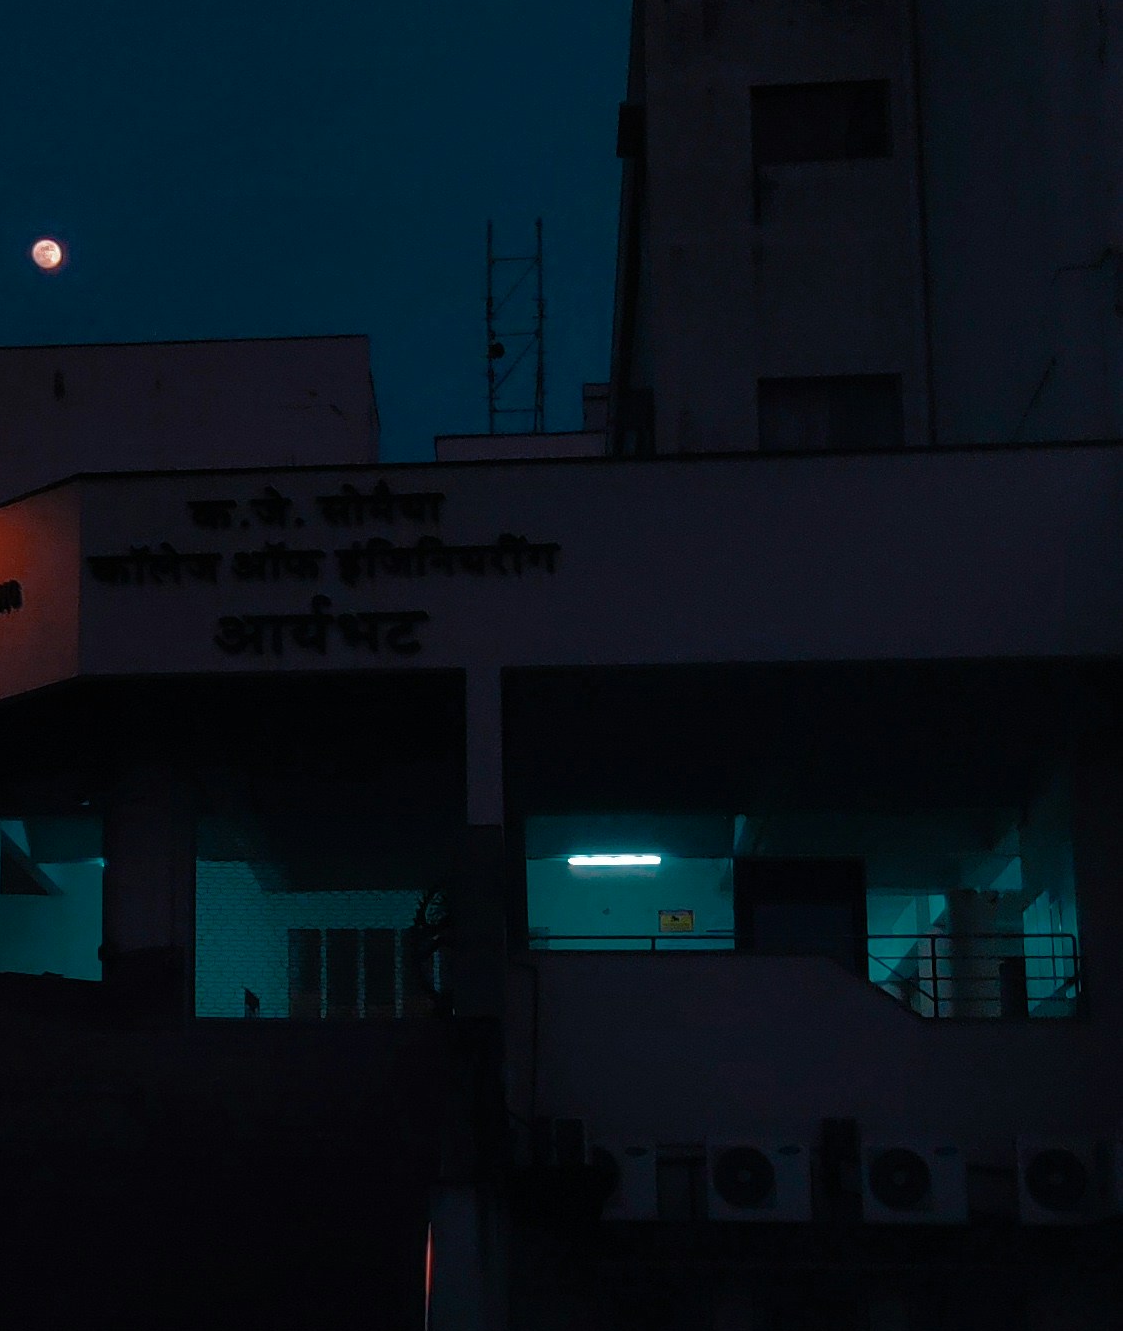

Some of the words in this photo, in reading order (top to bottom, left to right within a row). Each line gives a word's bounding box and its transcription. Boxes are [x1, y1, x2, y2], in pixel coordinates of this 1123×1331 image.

[315, 479, 446, 525] सोमैया
[87, 542, 223, 584] कॉलेज
[232, 541, 326, 581] ऑफ
[213, 594, 430, 655] आर्यभट
